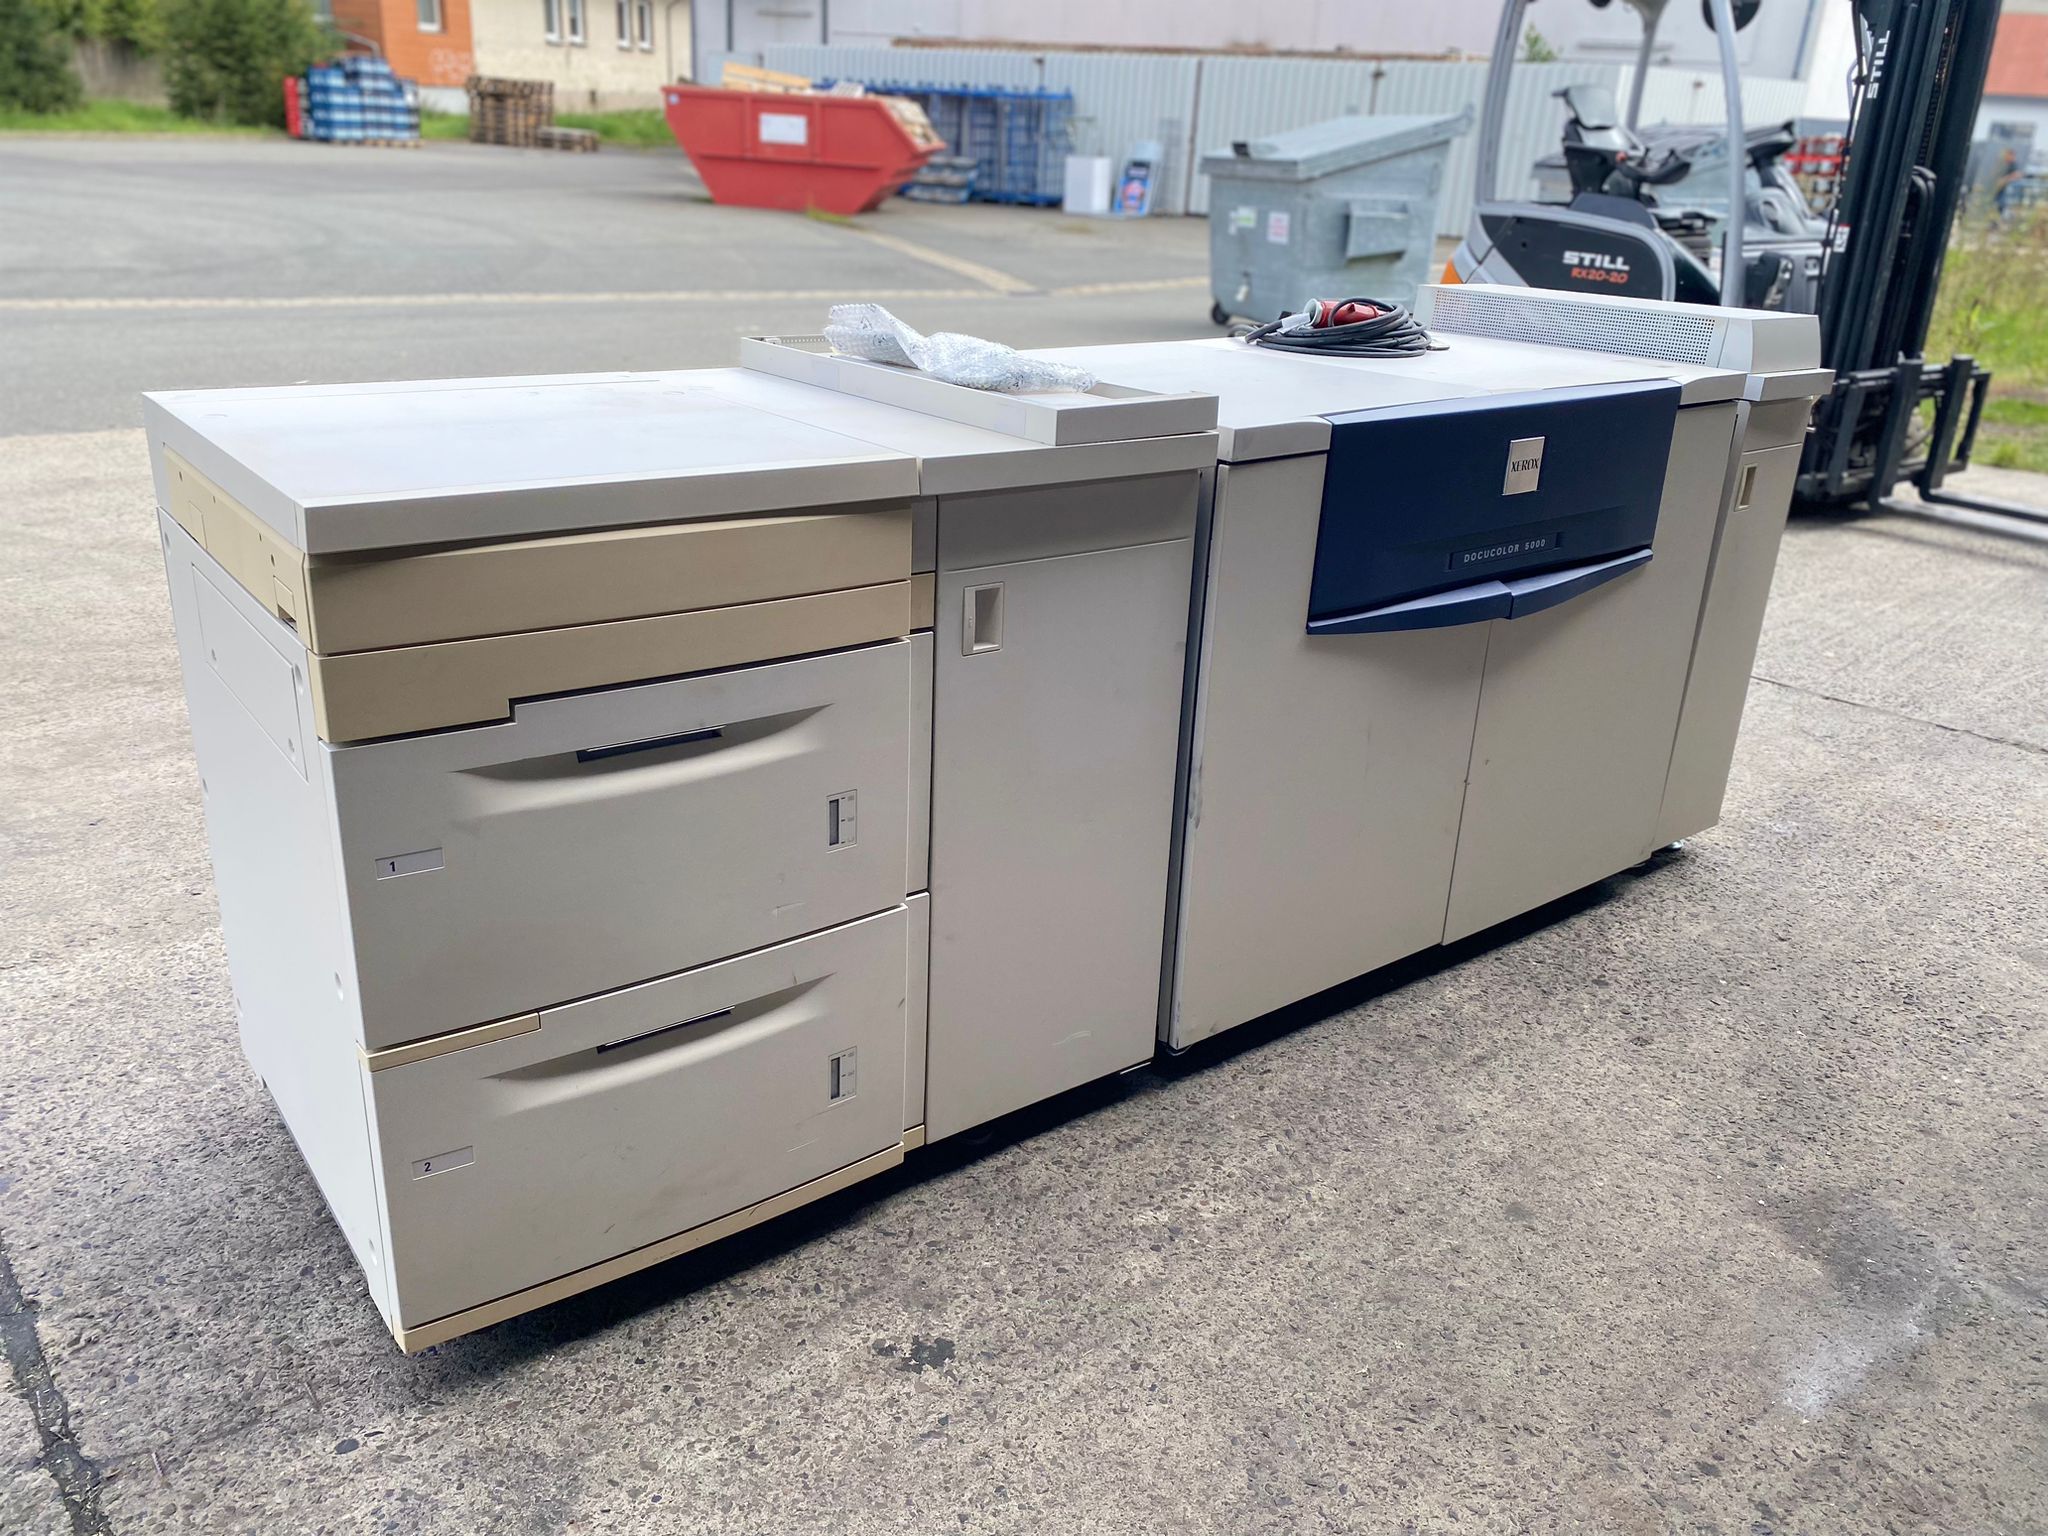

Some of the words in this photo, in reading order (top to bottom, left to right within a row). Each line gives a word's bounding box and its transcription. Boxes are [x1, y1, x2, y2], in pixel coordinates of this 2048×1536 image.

[1866, 30, 1890, 99] STILL
[1562, 250, 1630, 271] STILL
[1571, 267, 1628, 284] RX20-20
[1510, 457, 1540, 473] XEROX
[1463, 544, 1519, 563] DOCUCOLOR
[1525, 539, 1546, 551] 5000
[389, 861, 396, 872] 1
[424, 1162, 432, 1172] 2
